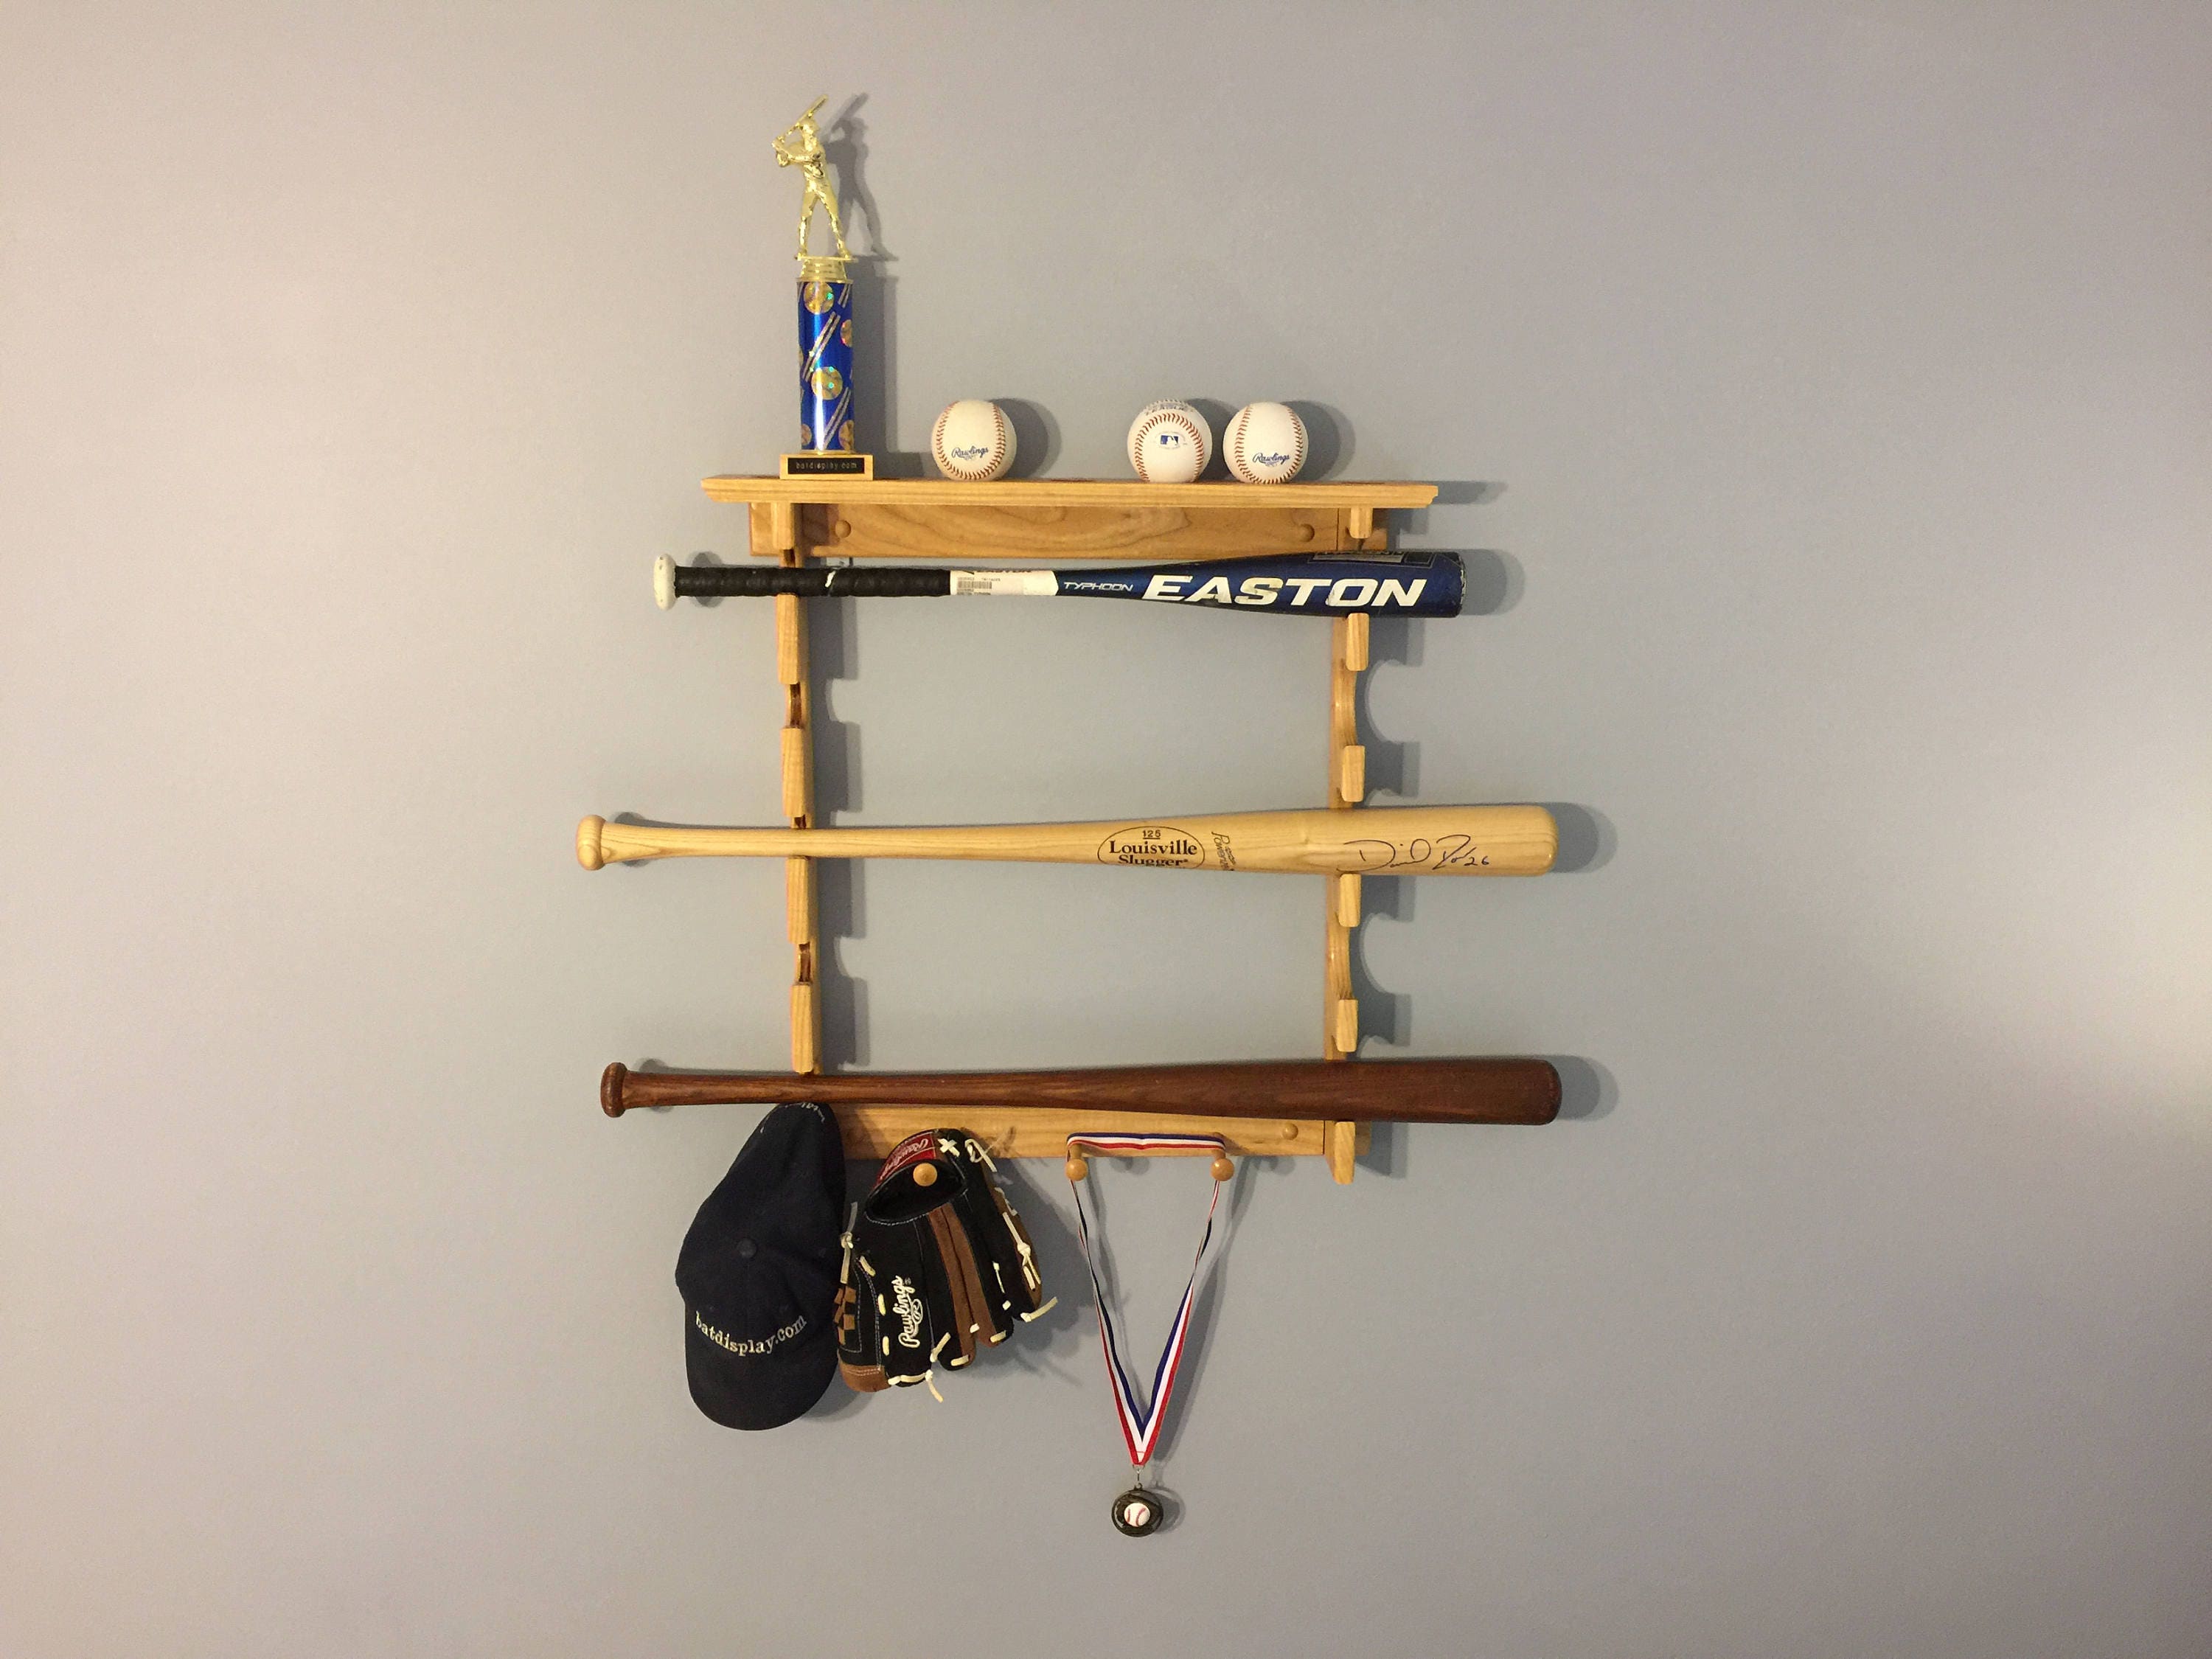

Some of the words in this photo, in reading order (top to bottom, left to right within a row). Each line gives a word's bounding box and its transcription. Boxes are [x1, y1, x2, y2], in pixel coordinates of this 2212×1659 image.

[951, 445, 989, 459] Rawlings
[1252, 452, 1290, 465] Rawlings
[1064, 582, 1134, 592] TYPHOON
[1141, 574, 1427, 607] EASTON
[1109, 839, 1198, 855] Louisville
[891, 1275, 922, 1348] Rawlings
[695, 1310, 807, 1357] batdisplay.com
